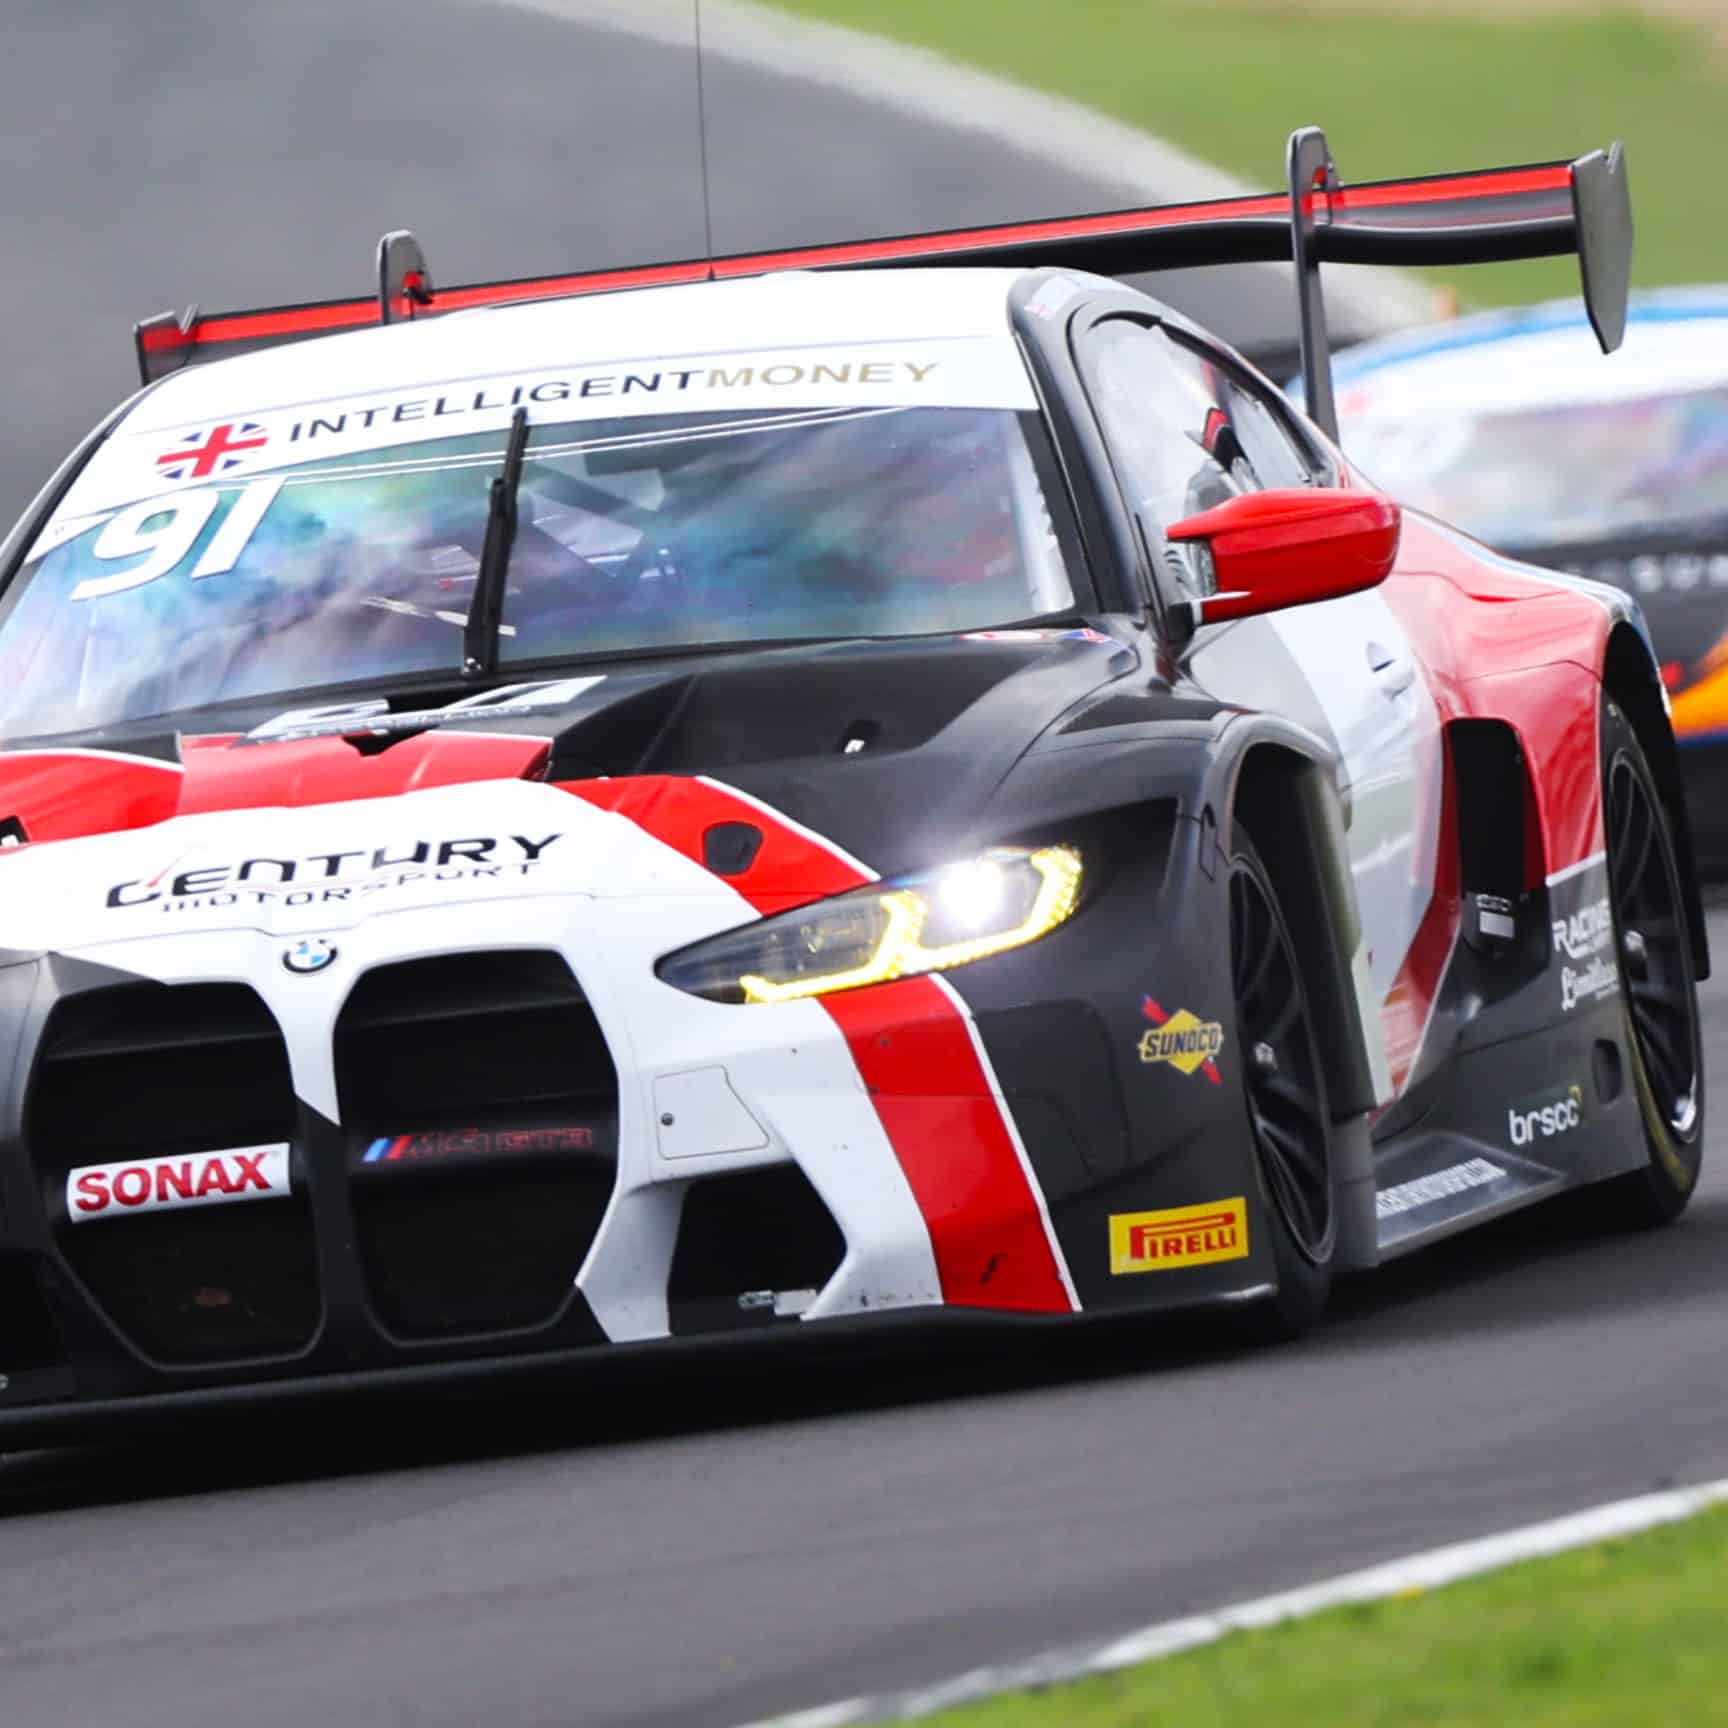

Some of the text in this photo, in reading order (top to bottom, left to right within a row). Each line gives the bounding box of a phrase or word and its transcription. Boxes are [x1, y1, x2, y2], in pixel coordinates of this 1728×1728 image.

[71, 475, 288, 602] 91
[105, 832, 564, 909] CENTURY
[1144, 1026, 1221, 1059] SUNOCO
[1509, 1096, 1579, 1145] brscc
[76, 1152, 270, 1211] SONAX
[1129, 1212, 1236, 1260] PIRELLI
